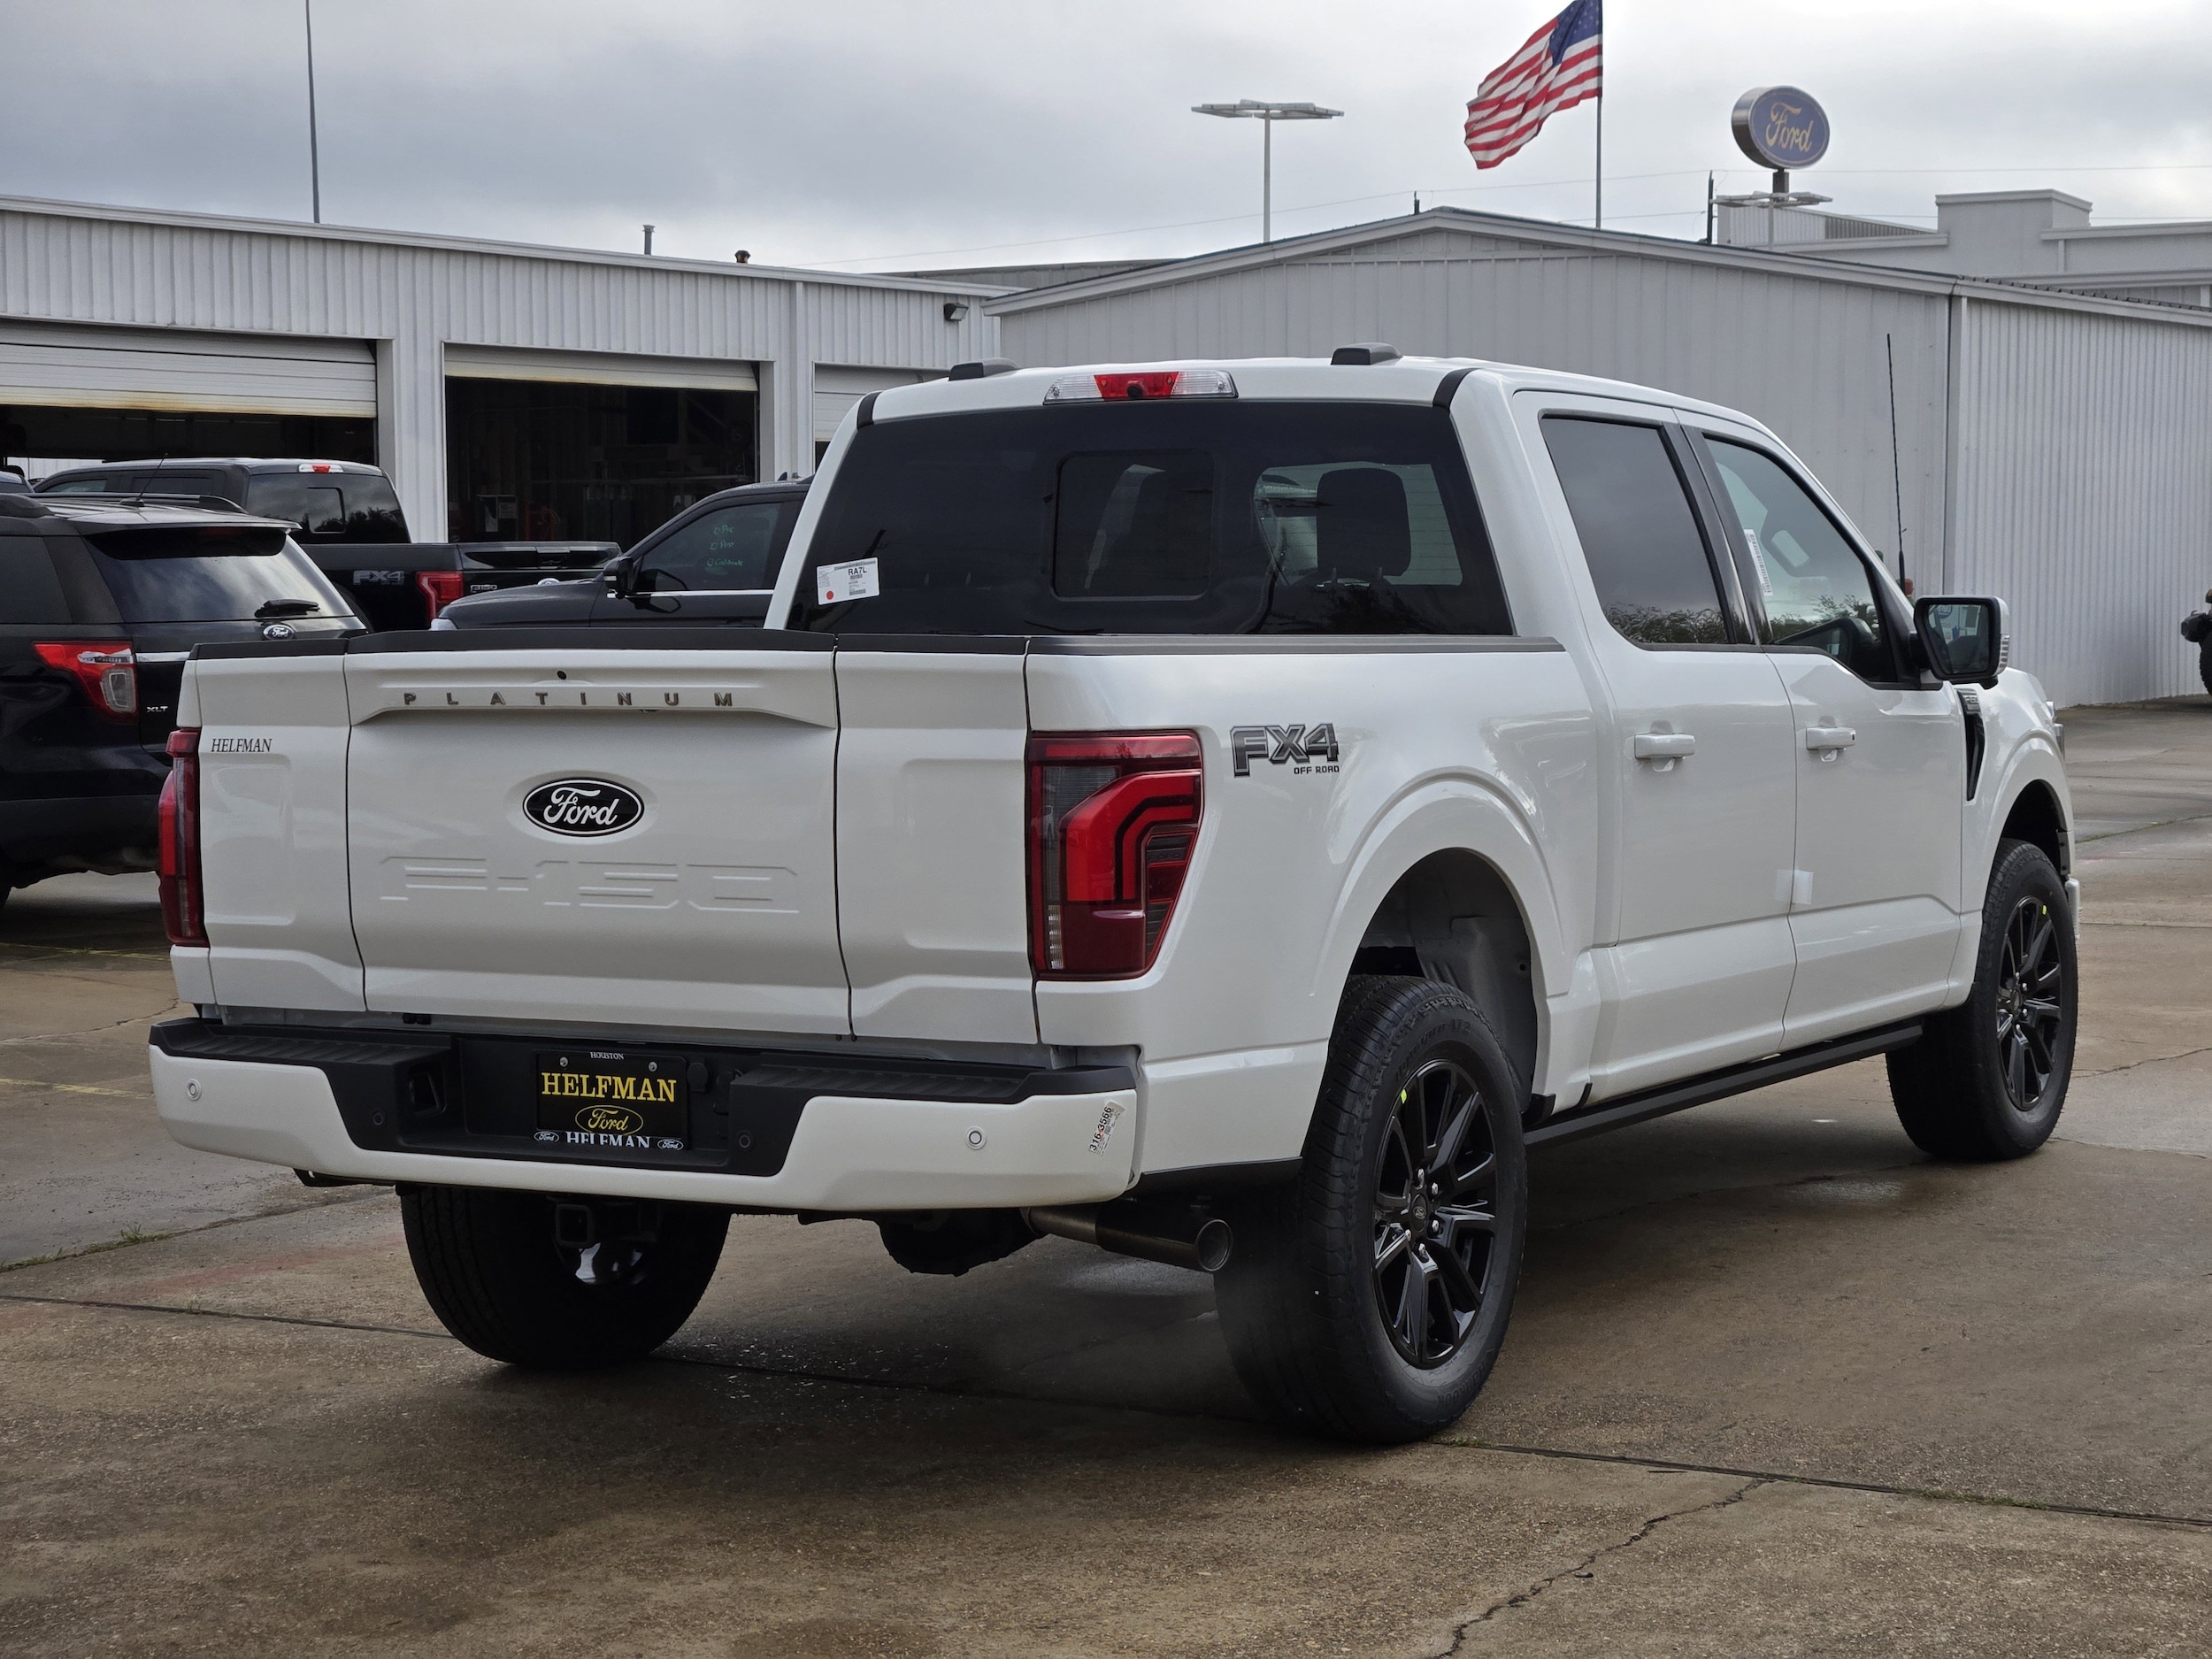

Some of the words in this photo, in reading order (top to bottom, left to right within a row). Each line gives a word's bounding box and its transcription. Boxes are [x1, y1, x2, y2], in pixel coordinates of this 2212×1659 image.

[1765, 101, 1814, 152] Ford
[353, 570, 404, 586] FX4
[848, 566, 867, 576] RA7L
[403, 691, 733, 707] PLATINUM
[211, 738, 273, 753] HELFMAN
[1230, 723, 1339, 778] FX4
[543, 787, 619, 826] Ford
[590, 1051, 625, 1060] HOUSTON
[541, 1071, 677, 1102] HELFMAN
[588, 1108, 630, 1132] Ford
